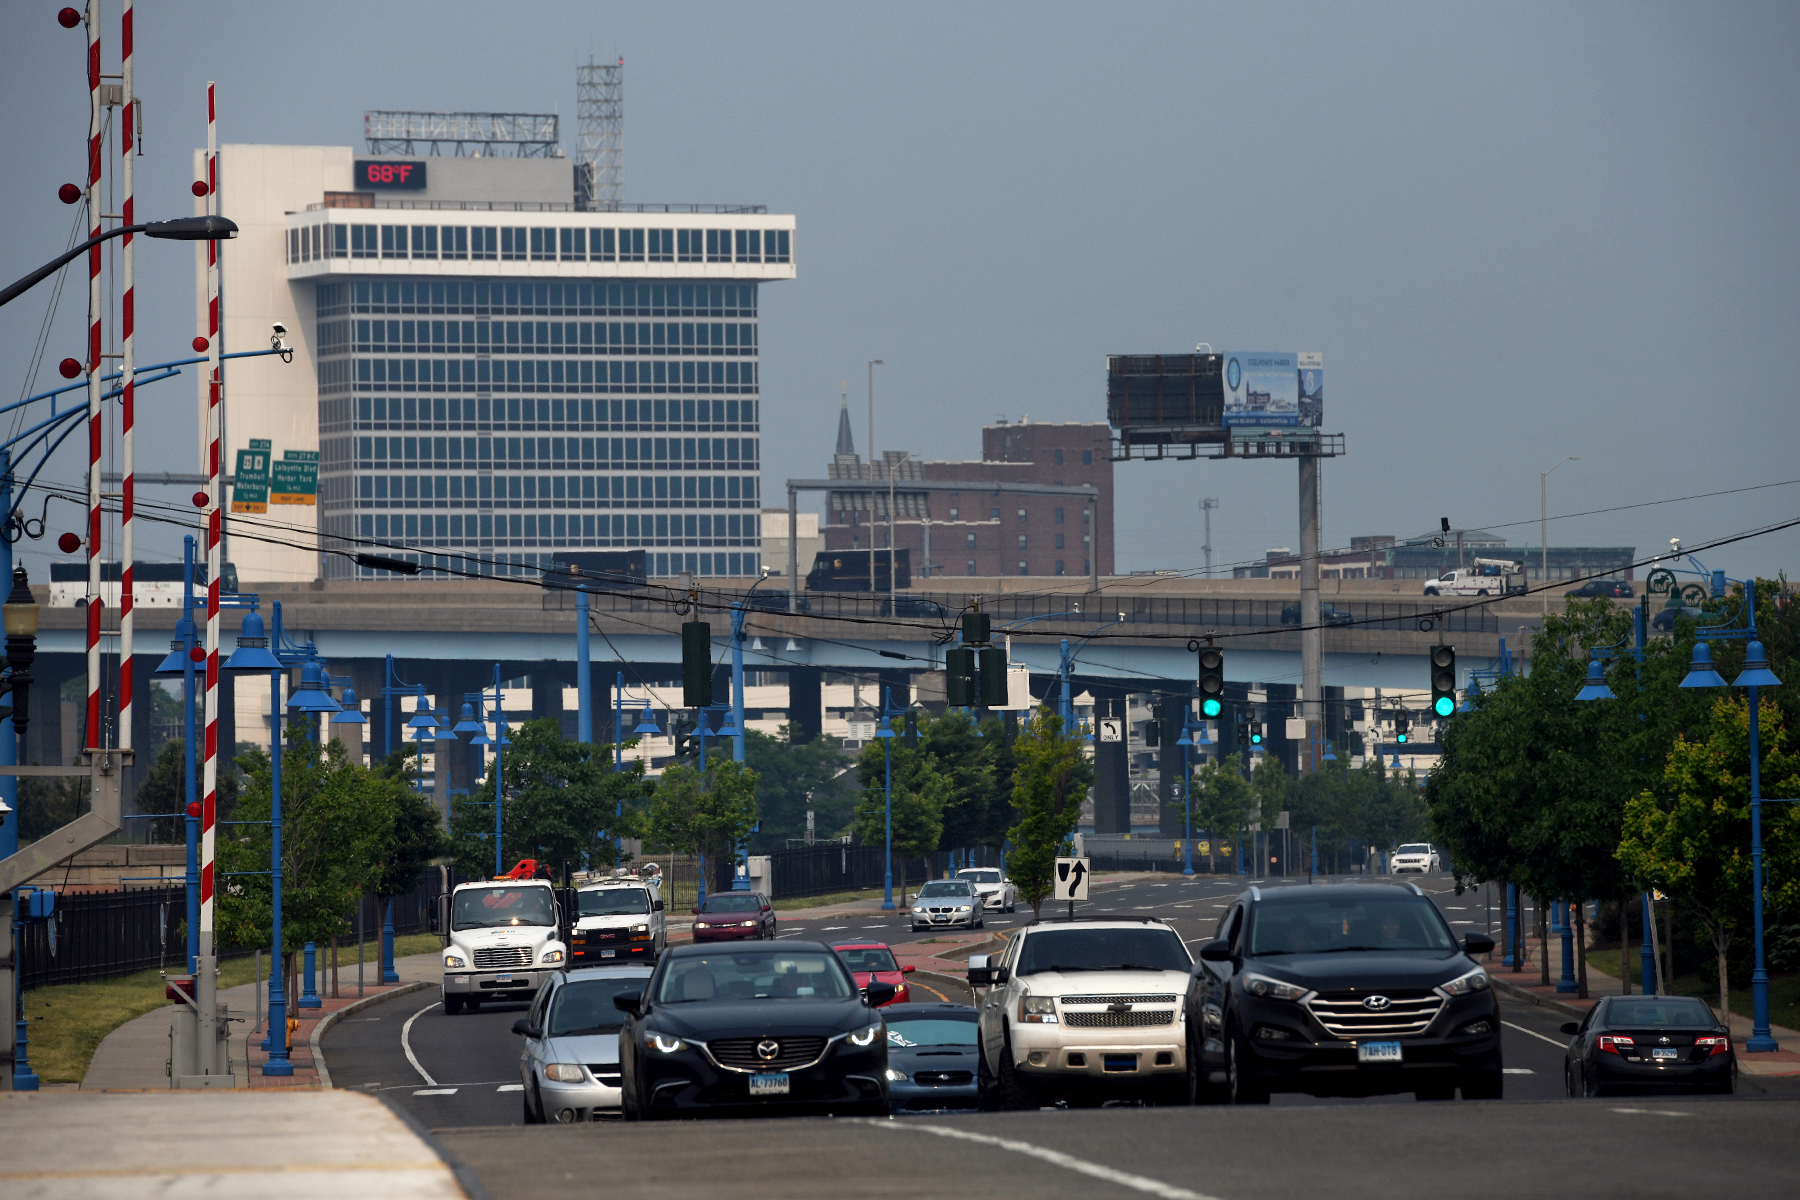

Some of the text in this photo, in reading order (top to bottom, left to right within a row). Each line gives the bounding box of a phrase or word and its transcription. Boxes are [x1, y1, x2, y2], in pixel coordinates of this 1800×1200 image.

[368, 165, 413, 183] 68°F
[244, 458, 251, 466] 25
[275, 464, 317, 473] Lafayette Blvd
[240, 472, 265, 480] Trumbull
[299, 475, 313, 483] Yard
[237, 482, 266, 492] Waterbury
